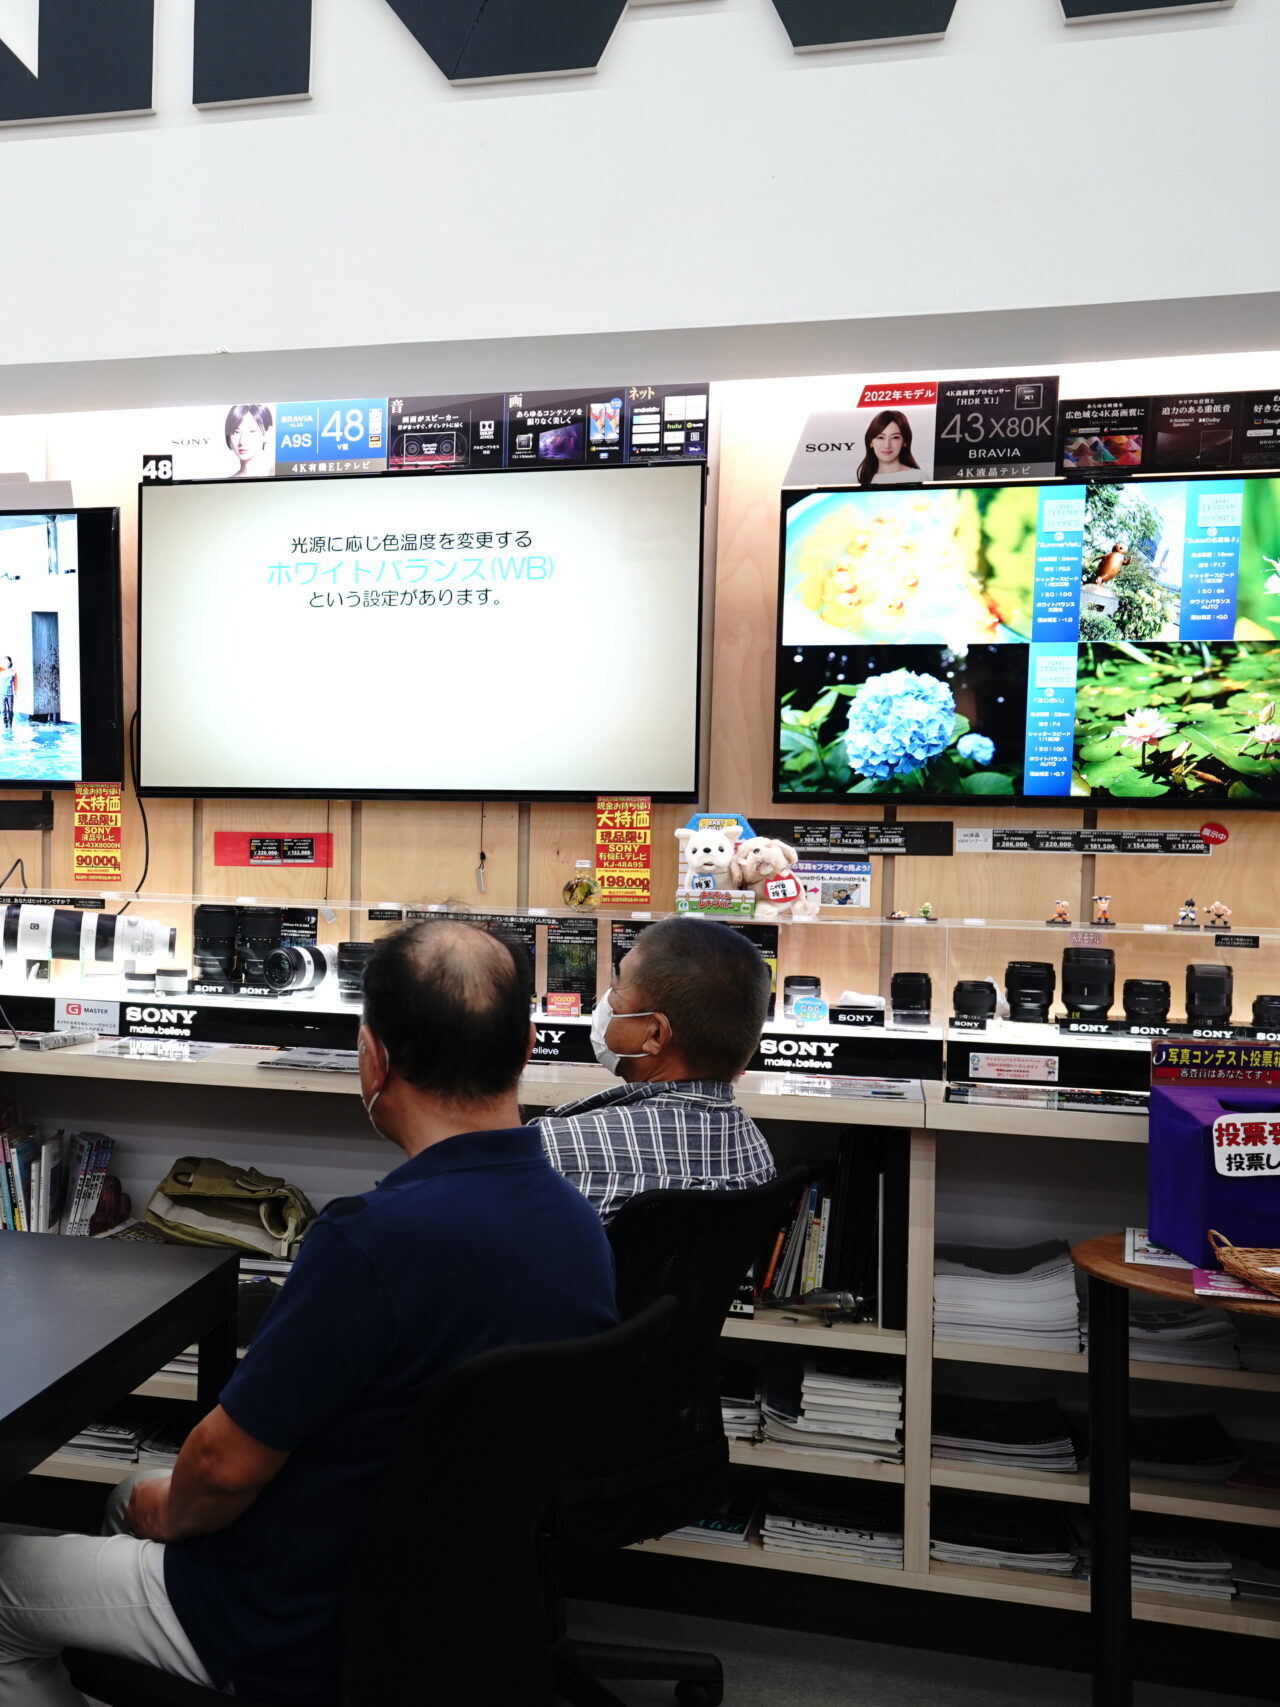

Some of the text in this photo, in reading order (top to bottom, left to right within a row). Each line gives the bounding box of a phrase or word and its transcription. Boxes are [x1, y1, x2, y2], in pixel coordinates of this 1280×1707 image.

[629, 387, 655, 400] ネット
[864, 389, 935, 402] 2022年モデル
[946, 387, 1011, 397] 4K高画質プロセッサー
[390, 399, 404, 413] 音
[321, 409, 364, 442] 48
[940, 412, 1052, 443] 43 X80K
[172, 438, 210, 446] SONY
[281, 433, 312, 449] A9S
[805, 442, 855, 453] SONY
[968, 448, 1020, 459] BRAVIA
[142, 460, 172, 479] 48
[291, 460, 371, 474] 4K有機ELテレビ
[956, 465, 1033, 478] 4K液晶テレビ
[290, 530, 533, 554] 光源に応じ色温度を変更する
[267, 554, 555, 586] ホワイトバランス(WB)
[308, 588, 500, 608] という設定があります。
[75, 795, 121, 811] 大特価
[78, 814, 118, 826] 現品限り
[597, 811, 650, 827] 大特価
[600, 831, 647, 843] 現品限り
[1071, 935, 1101, 944] 人気モデル
[195, 985, 224, 993] SONY
[239, 987, 270, 995] SONY
[68, 1004, 79, 1014] G
[125, 1006, 197, 1024] SONY
[838, 1014, 874, 1022] SONY
[954, 1020, 979, 1028] SONY
[129, 1025, 191, 1036] make.believe
[1070, 1023, 1109, 1032] SONY
[1130, 1025, 1170, 1035] SONY
[535, 1030, 565, 1044] NY
[1193, 1029, 1233, 1039] SONY
[1256, 1032, 1280, 1041] SO
[532, 1046, 559, 1055] elieve
[760, 1040, 839, 1057] SONY
[764, 1057, 832, 1069] make.believe
